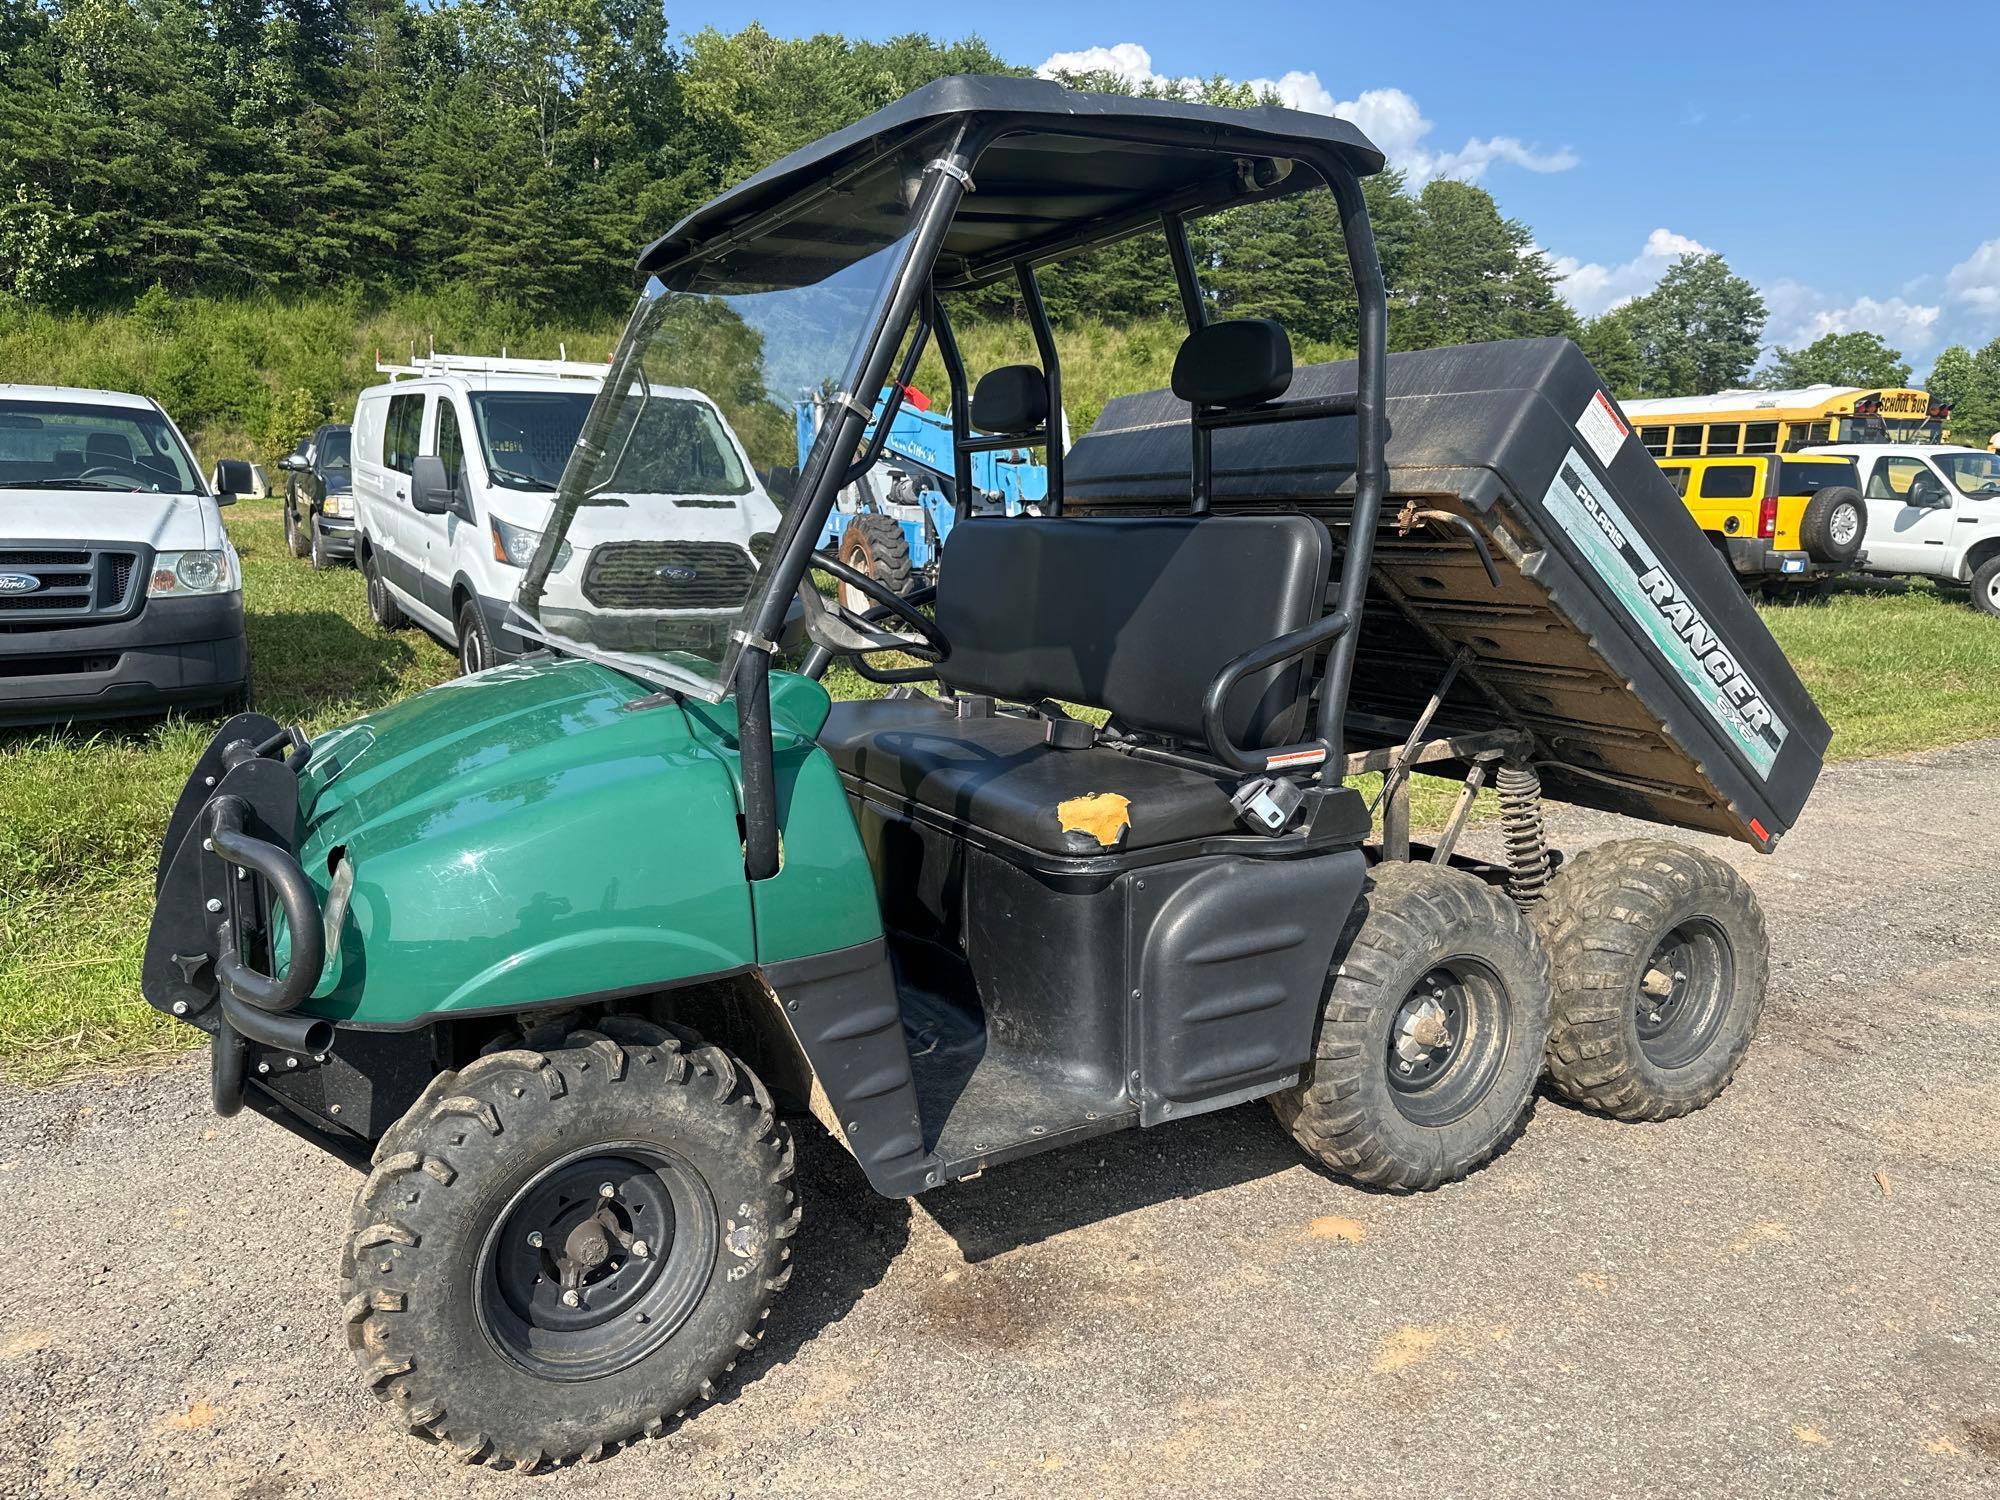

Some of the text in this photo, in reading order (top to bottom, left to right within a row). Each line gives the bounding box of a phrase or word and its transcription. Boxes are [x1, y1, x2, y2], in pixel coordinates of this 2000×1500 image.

[1880, 397, 1927, 413] SCHOOL BUS
[1576, 484, 1626, 549] POLARIS
[1638, 566, 1772, 735] RANGER
